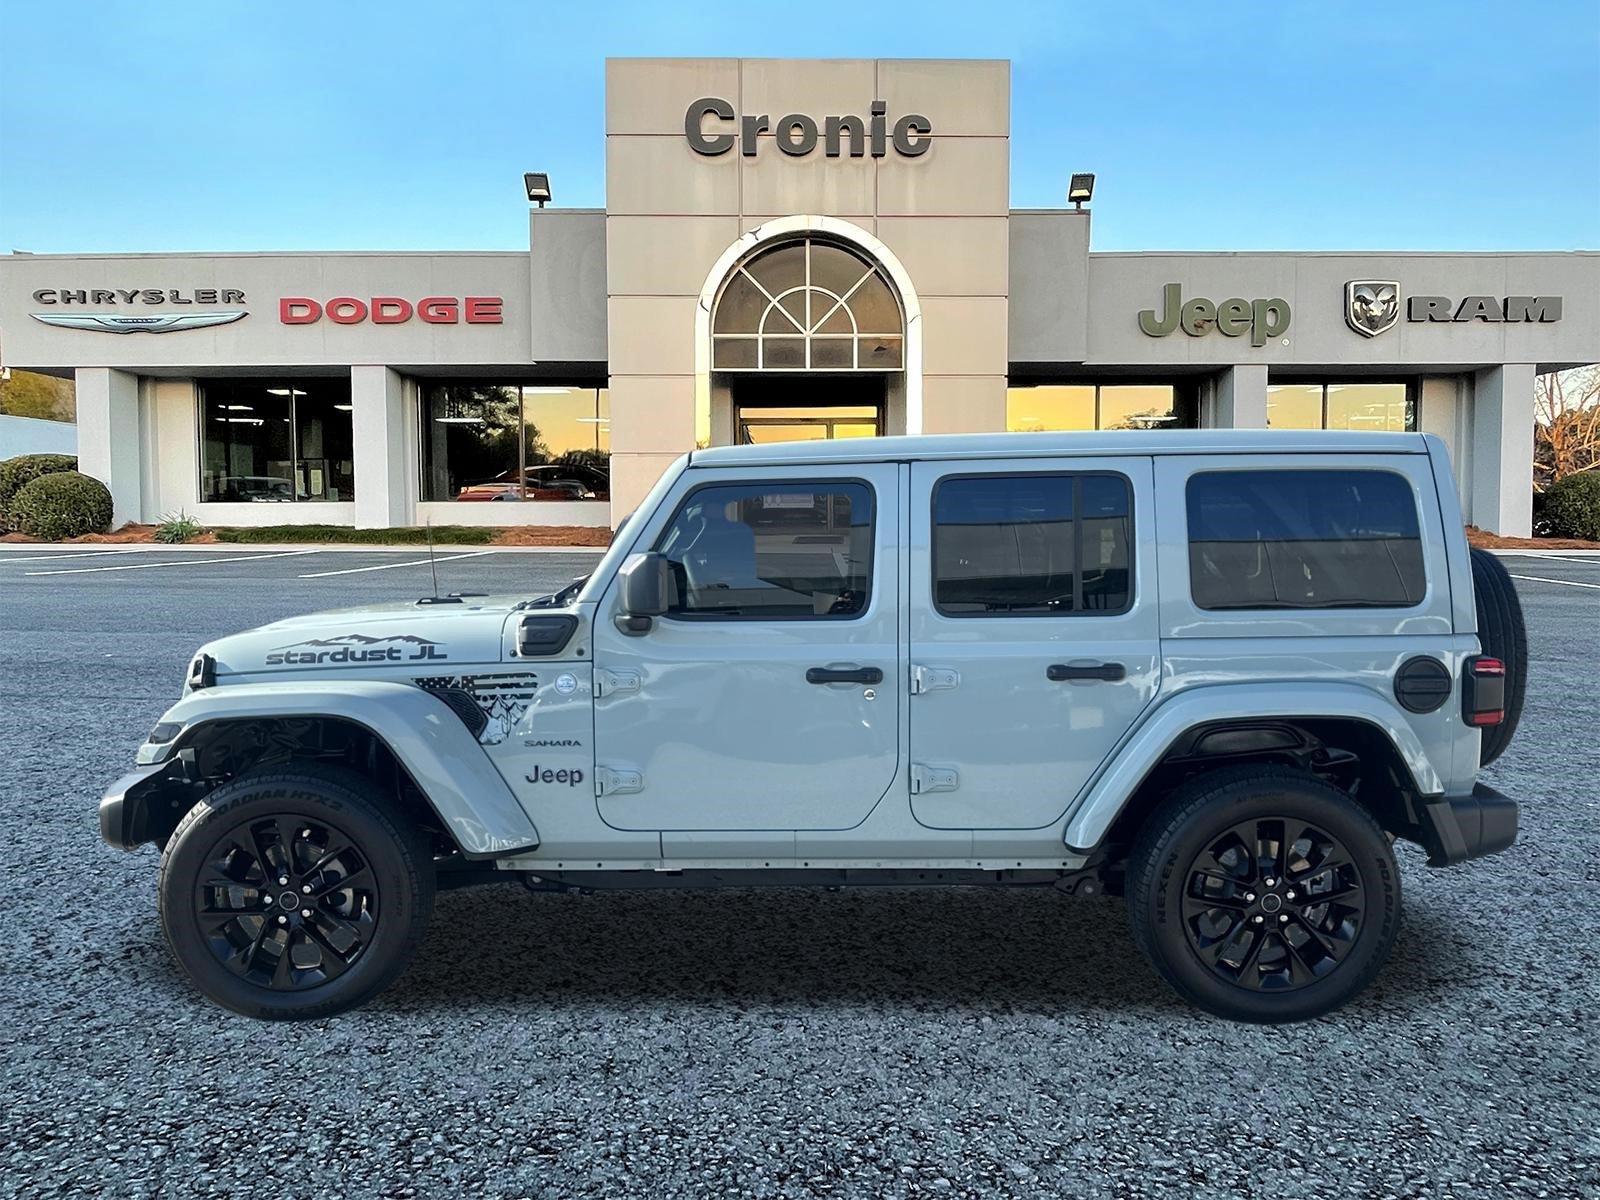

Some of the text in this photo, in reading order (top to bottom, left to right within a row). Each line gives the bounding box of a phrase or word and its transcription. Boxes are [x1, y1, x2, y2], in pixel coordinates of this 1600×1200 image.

[684, 97, 932, 158] Cronic
[32, 289, 247, 304] CHRYSLER
[1407, 296, 1562, 323] RAM
[280, 296, 504, 325] DODGE
[1138, 283, 1292, 347] Jeep
[266, 645, 447, 665] stardust JL
[525, 765, 583, 787] Jeep
